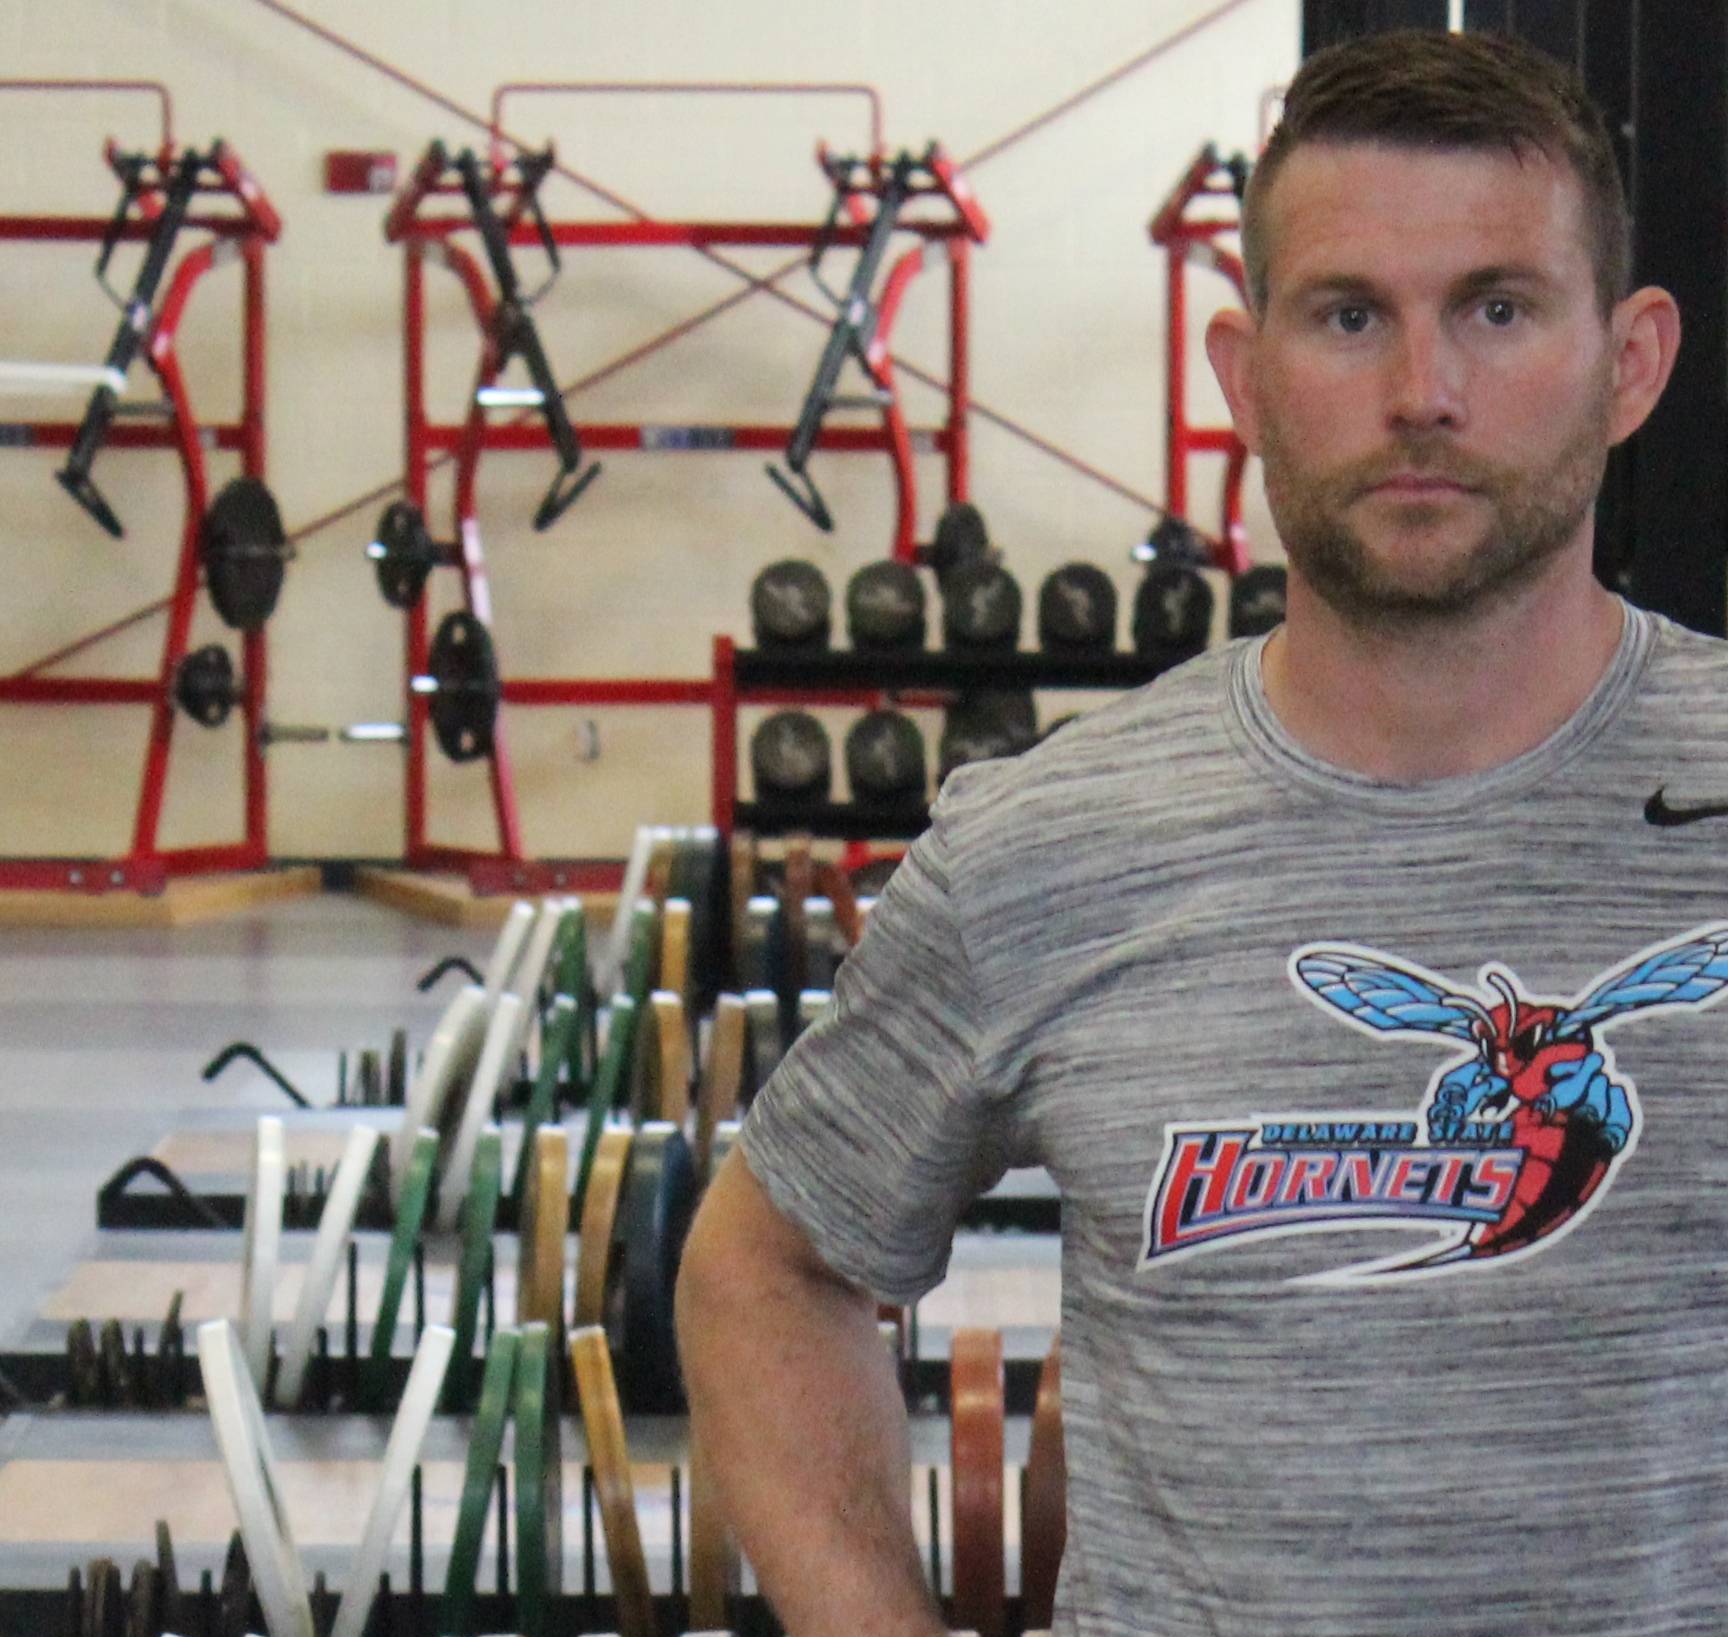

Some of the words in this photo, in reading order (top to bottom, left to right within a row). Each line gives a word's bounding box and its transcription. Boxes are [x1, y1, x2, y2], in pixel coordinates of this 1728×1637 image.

[1261, 1121, 1417, 1143] DELAWARE
[1429, 1121, 1514, 1143] STATE
[1152, 1130, 1526, 1250] HORNETS
